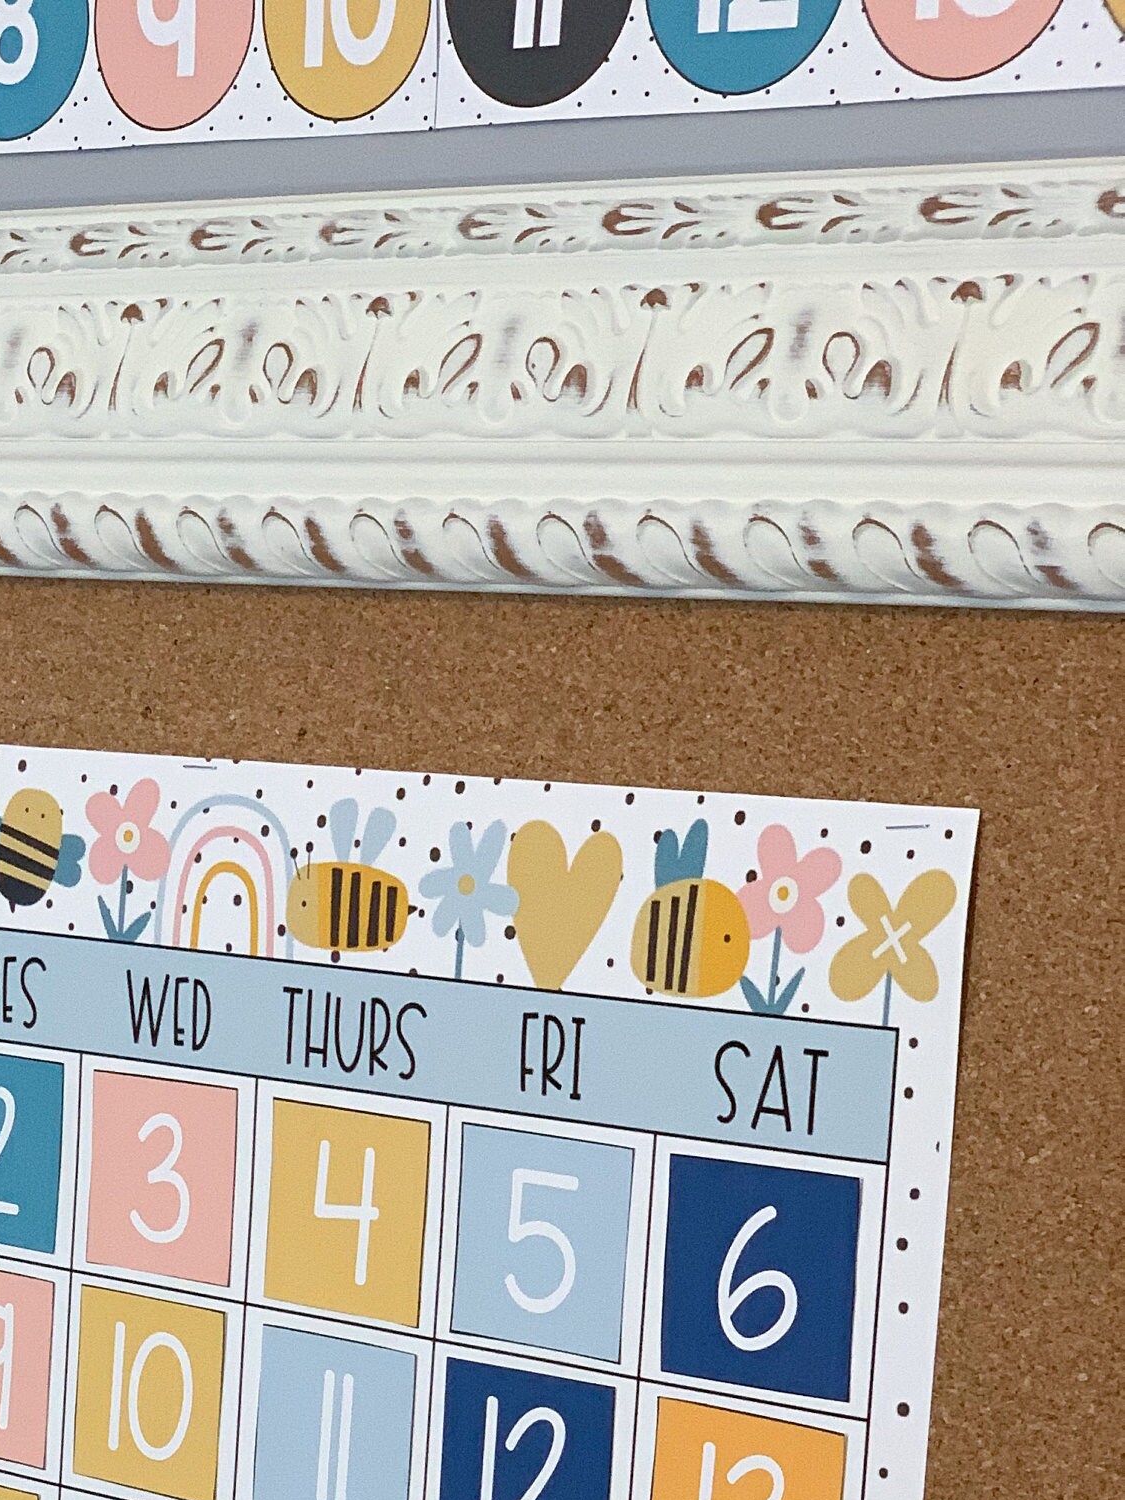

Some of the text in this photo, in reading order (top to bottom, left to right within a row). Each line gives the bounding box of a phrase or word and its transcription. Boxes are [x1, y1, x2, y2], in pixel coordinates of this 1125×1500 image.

[127, 970, 211, 1051] WED
[283, 987, 427, 1080] THURS
[521, 1013, 585, 1100] FRI
[715, 1041, 829, 1135] SAT
[130, 1113, 190, 1243] 3
[314, 1140, 379, 1285] 4
[505, 1168, 579, 1313] 5
[718, 1206, 797, 1351] 6
[108, 1322, 193, 1460] 10
